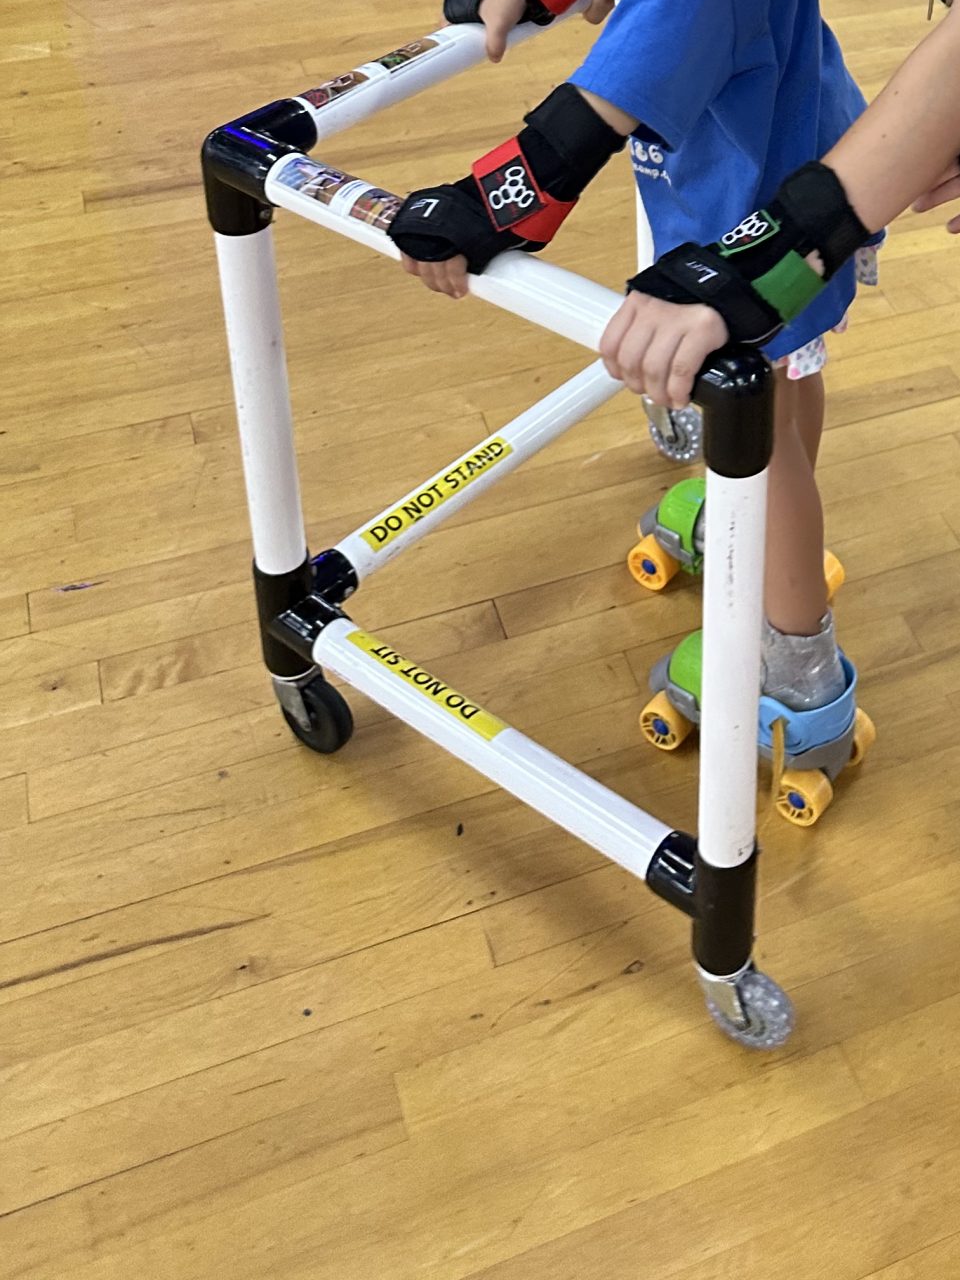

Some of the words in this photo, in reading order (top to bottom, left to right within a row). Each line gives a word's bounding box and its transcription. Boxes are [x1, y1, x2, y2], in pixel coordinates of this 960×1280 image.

[369, 515, 403, 542] DO
[402, 483, 444, 519] NOT
[444, 441, 504, 489] STAND
[369, 645, 406, 666] SIT
[400, 666, 449, 696] NOT
[446, 694, 481, 720] DO
